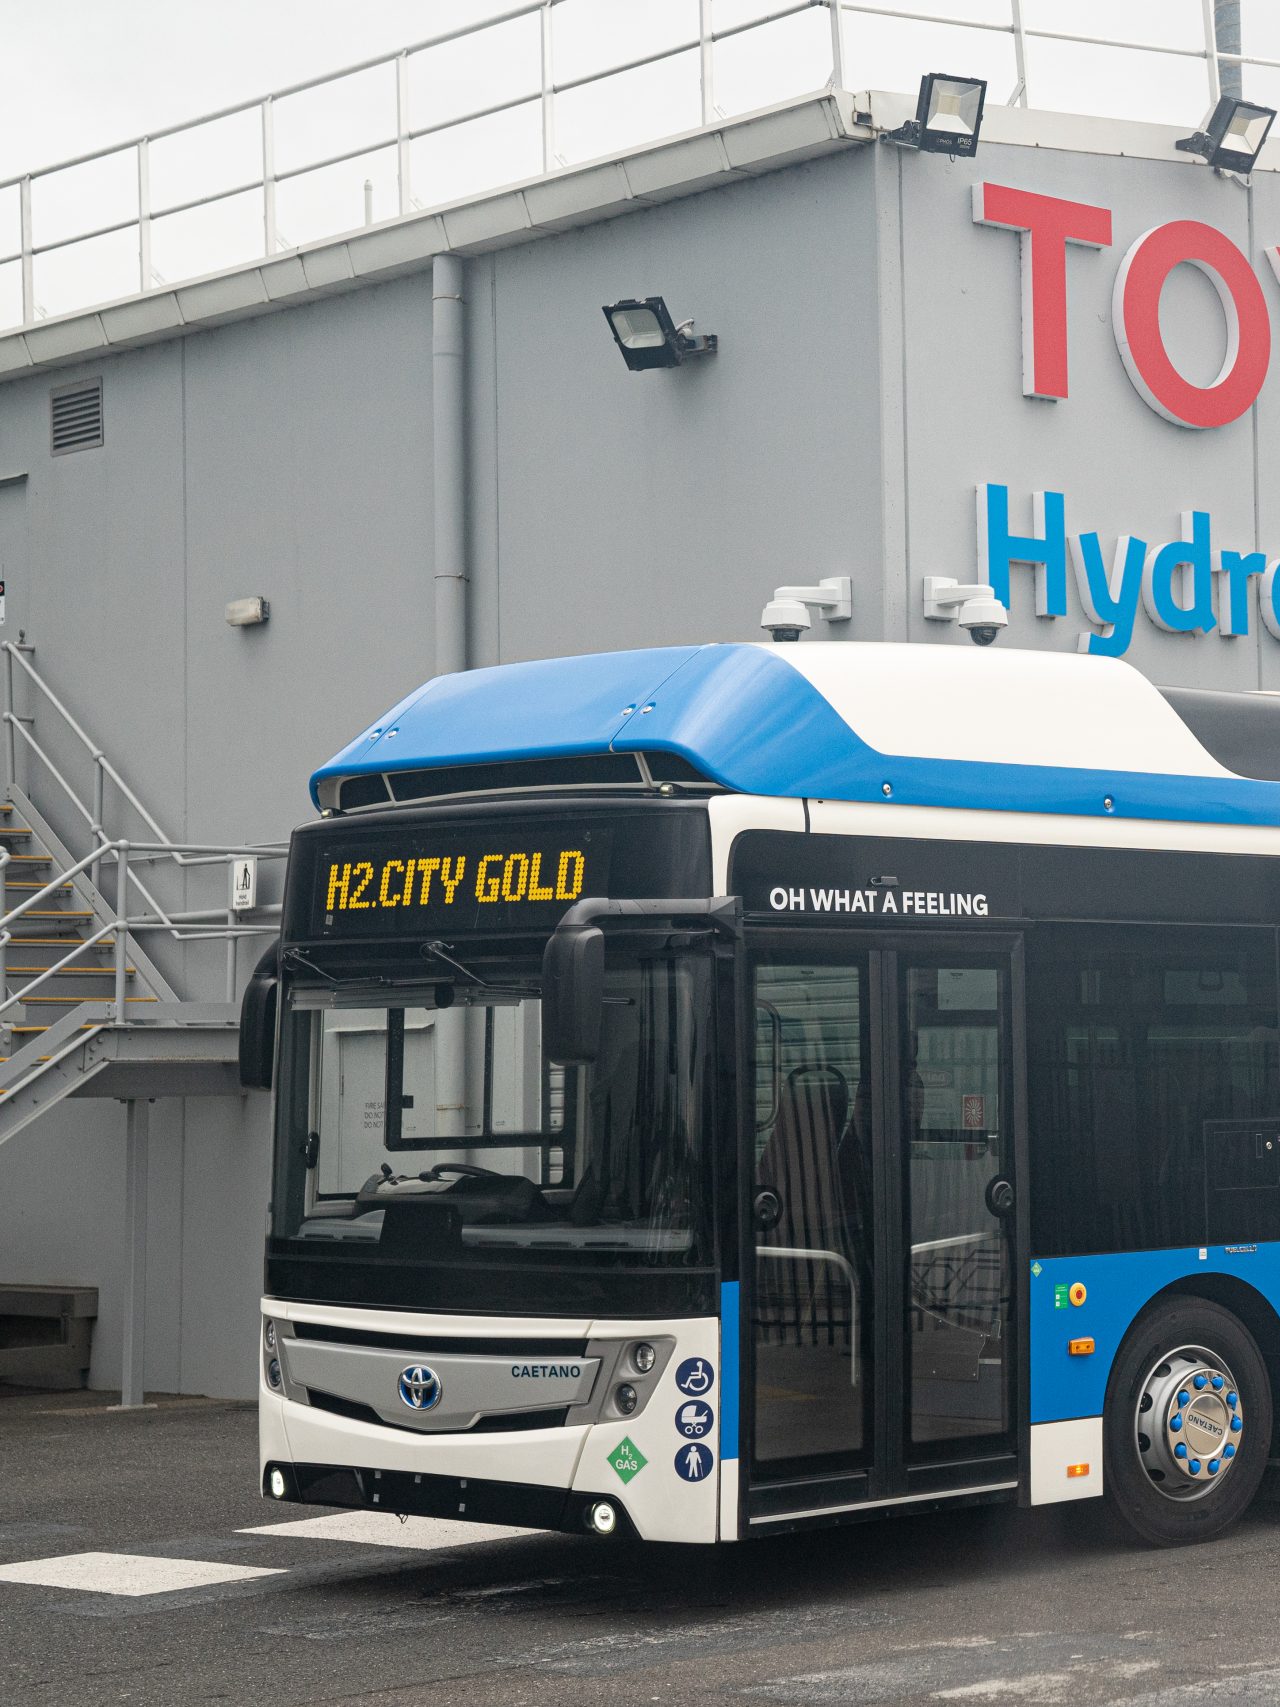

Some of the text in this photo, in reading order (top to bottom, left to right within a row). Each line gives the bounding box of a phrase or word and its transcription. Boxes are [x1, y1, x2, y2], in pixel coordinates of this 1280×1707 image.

[326, 851, 585, 910] H2.CITY GOLD
[769, 887, 989, 916] OH WHAT A FEELING
[511, 1365, 581, 1378] CAETANO
[1187, 1413, 1223, 1436] CAETANO
[615, 1459, 638, 1471] GAS
